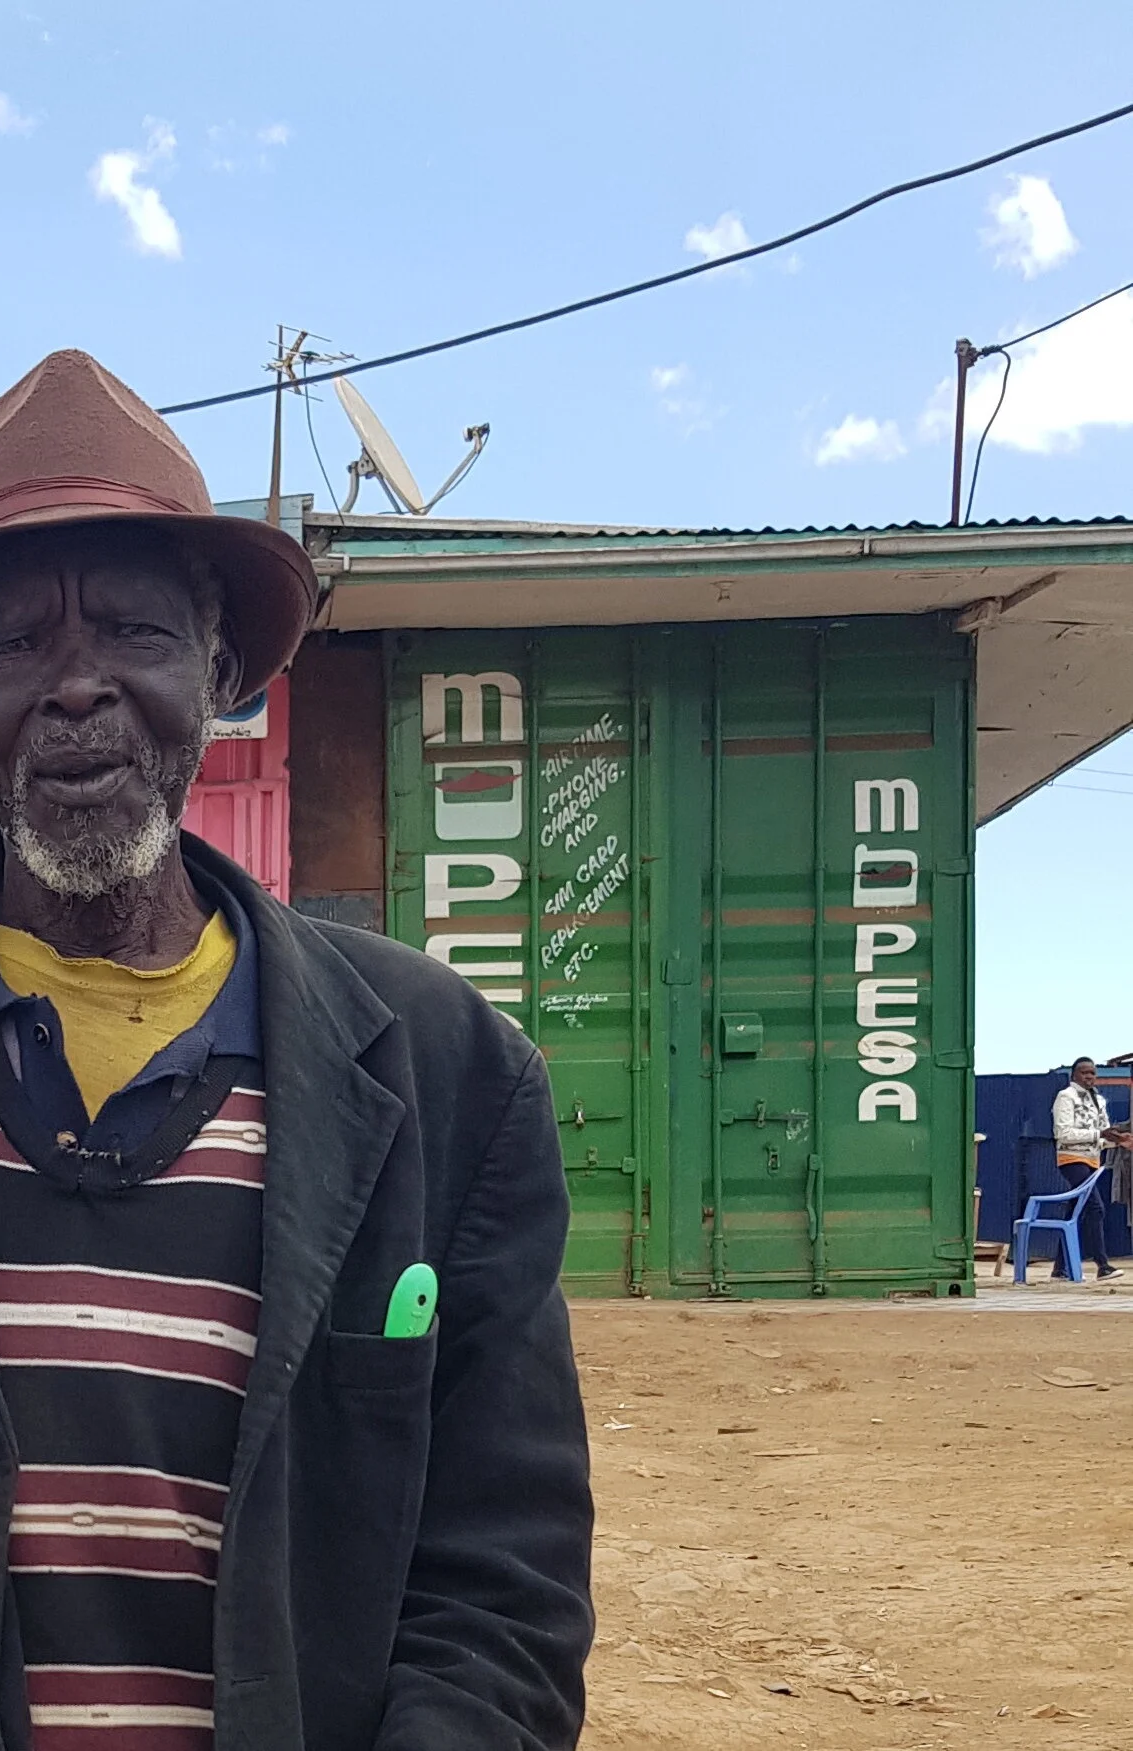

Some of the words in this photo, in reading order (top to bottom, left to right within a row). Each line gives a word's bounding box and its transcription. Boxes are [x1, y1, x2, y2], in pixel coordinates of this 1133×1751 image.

[545, 880, 575, 915] SIM
[576, 835, 618, 882] CARD
[565, 813, 598, 853] AND
[424, 853, 524, 1031] PE
[541, 853, 630, 969] REPLACEMENT
[854, 923, 918, 1121] PESA
